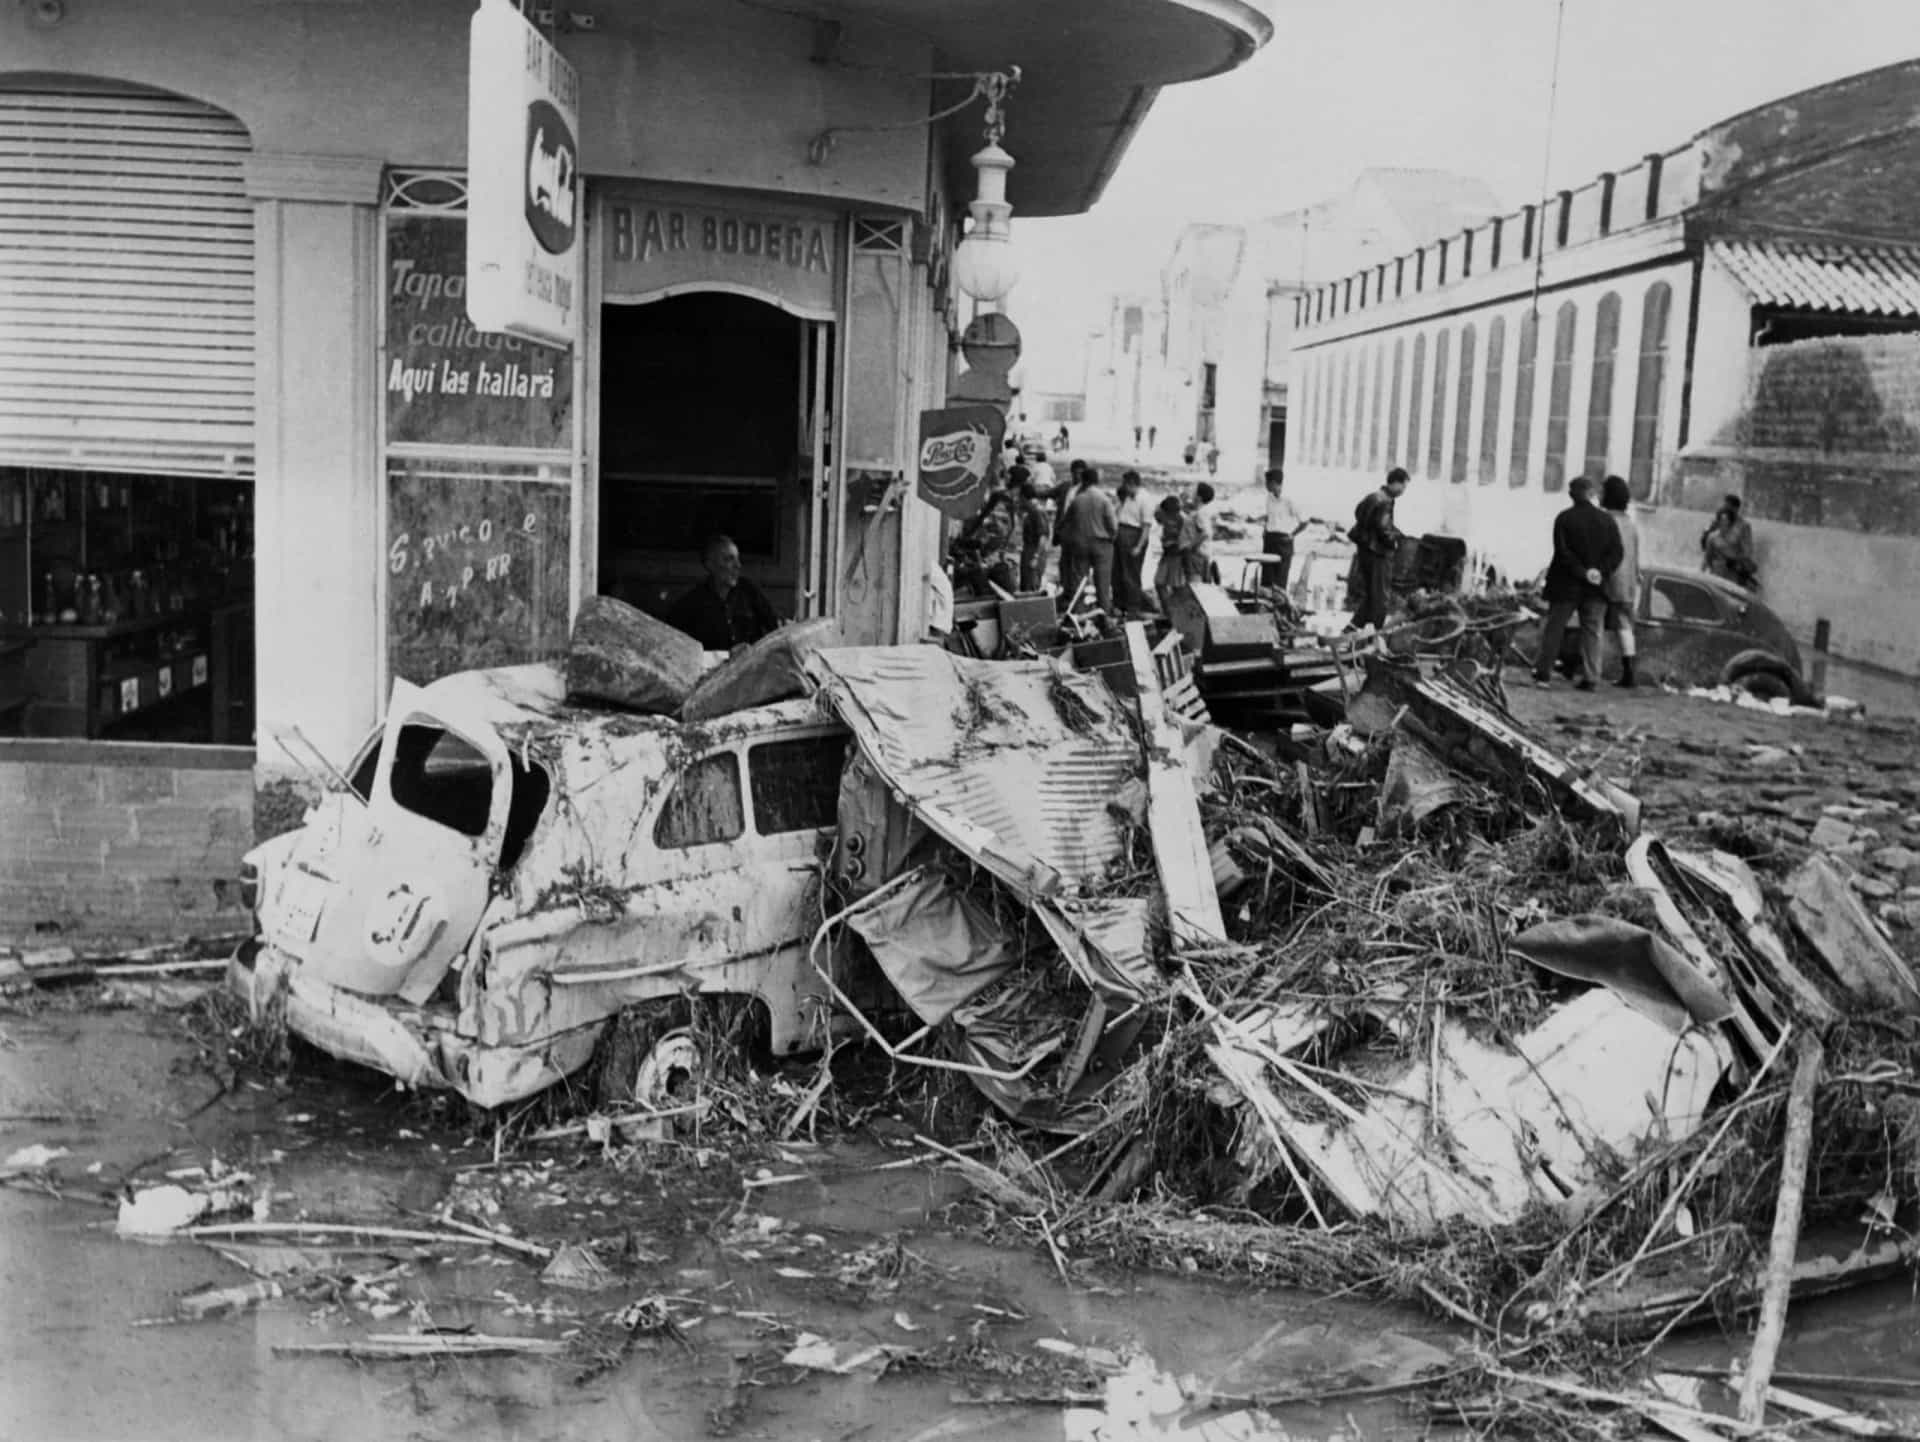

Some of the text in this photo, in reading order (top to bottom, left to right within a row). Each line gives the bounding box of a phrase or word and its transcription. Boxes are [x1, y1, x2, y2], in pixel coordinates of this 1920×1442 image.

[614, 207, 831, 273] BAR BODEGA
[392, 259, 465, 311] Tapa
[440, 359, 470, 396] las
